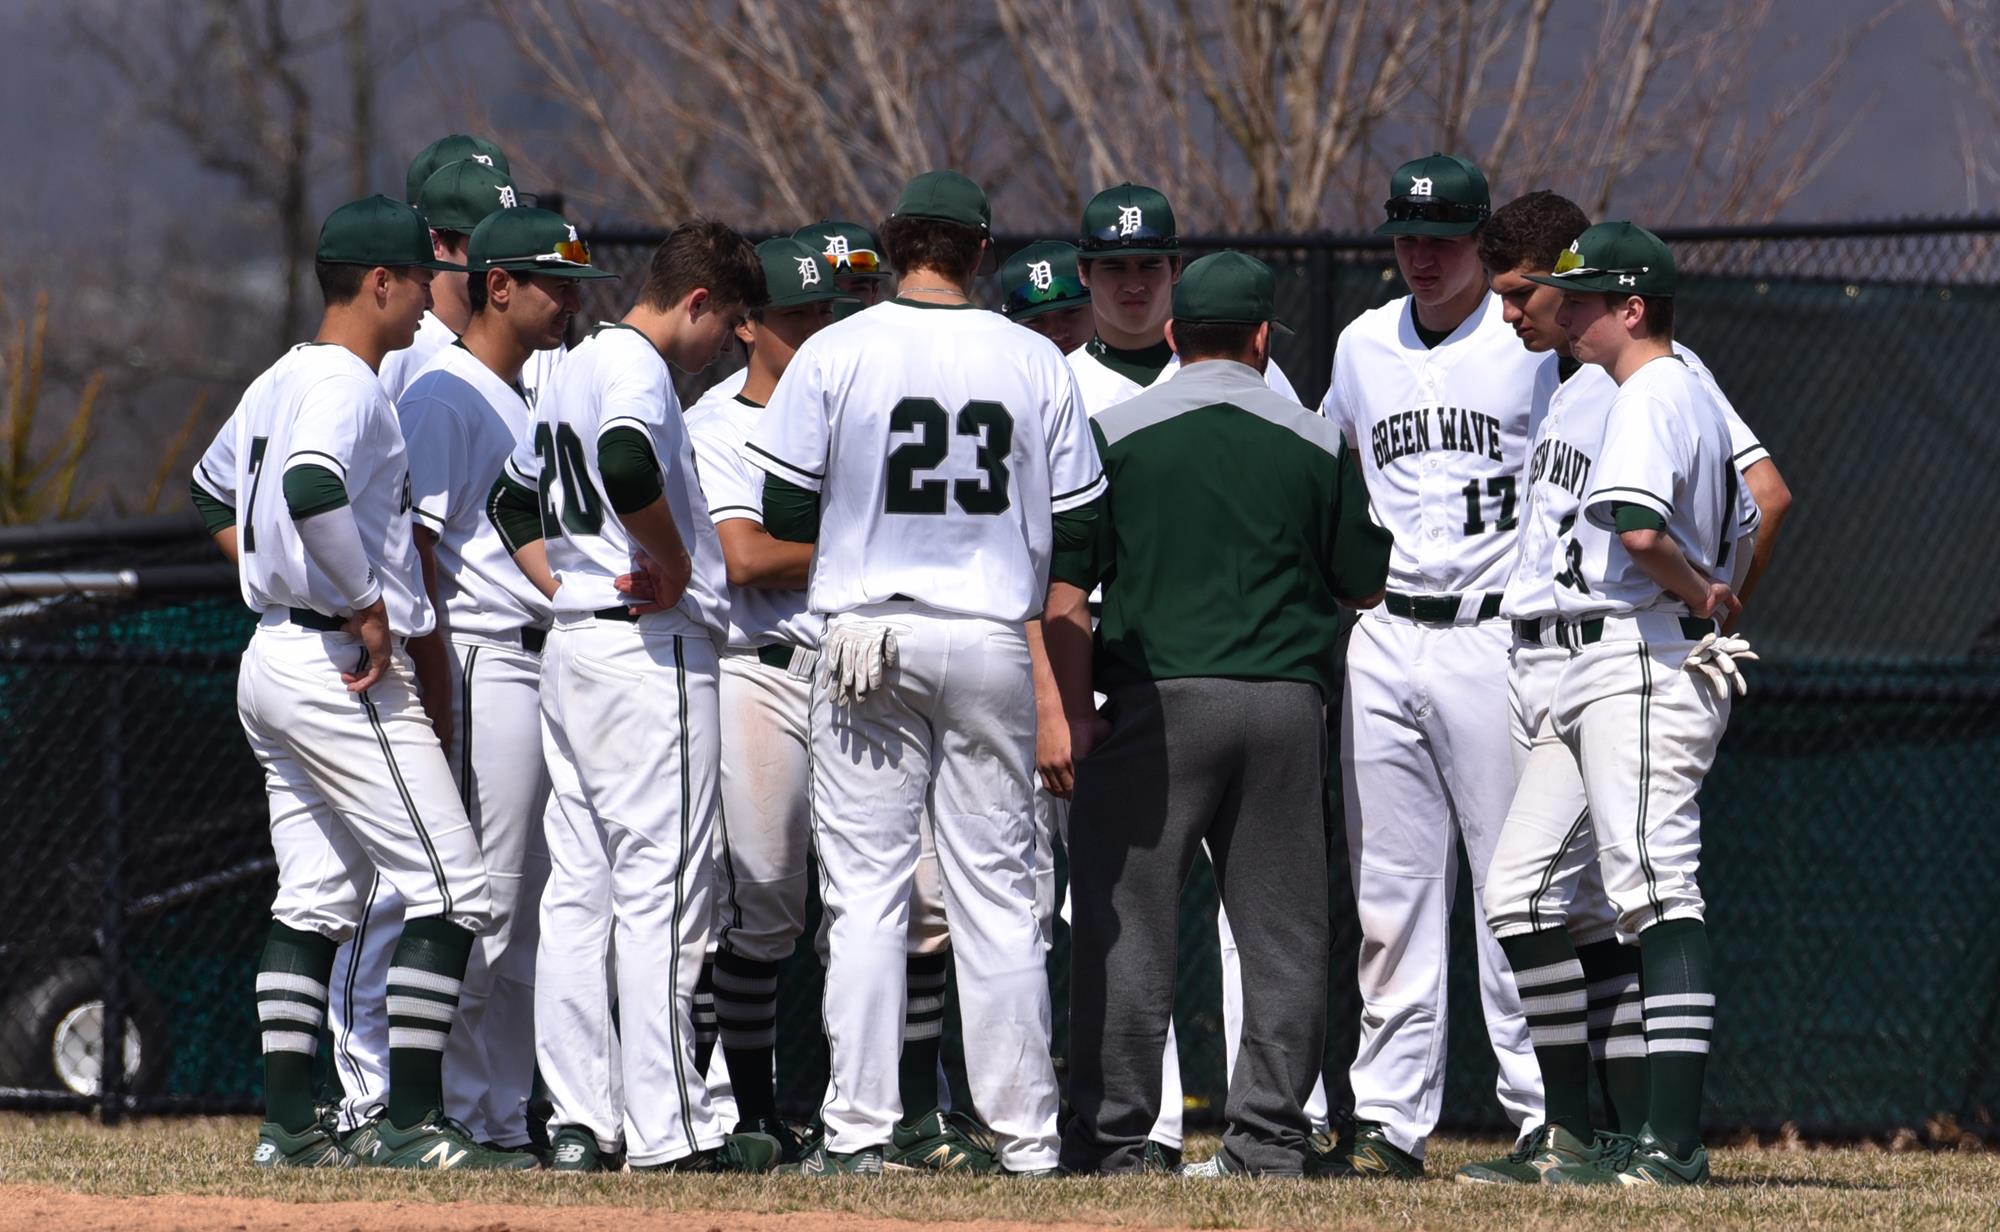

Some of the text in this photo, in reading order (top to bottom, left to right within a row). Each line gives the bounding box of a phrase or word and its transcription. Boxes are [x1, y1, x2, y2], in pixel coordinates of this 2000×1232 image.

[1117, 204, 1142, 237] D
[793, 256, 821, 290] D
[1026, 260, 1053, 290] D
[884, 396, 1015, 516] 23
[1371, 406, 1503, 471] GREEN WAVE
[244, 435, 269, 553] 7
[535, 421, 606, 540] 20
[1461, 475, 1519, 537] 17
